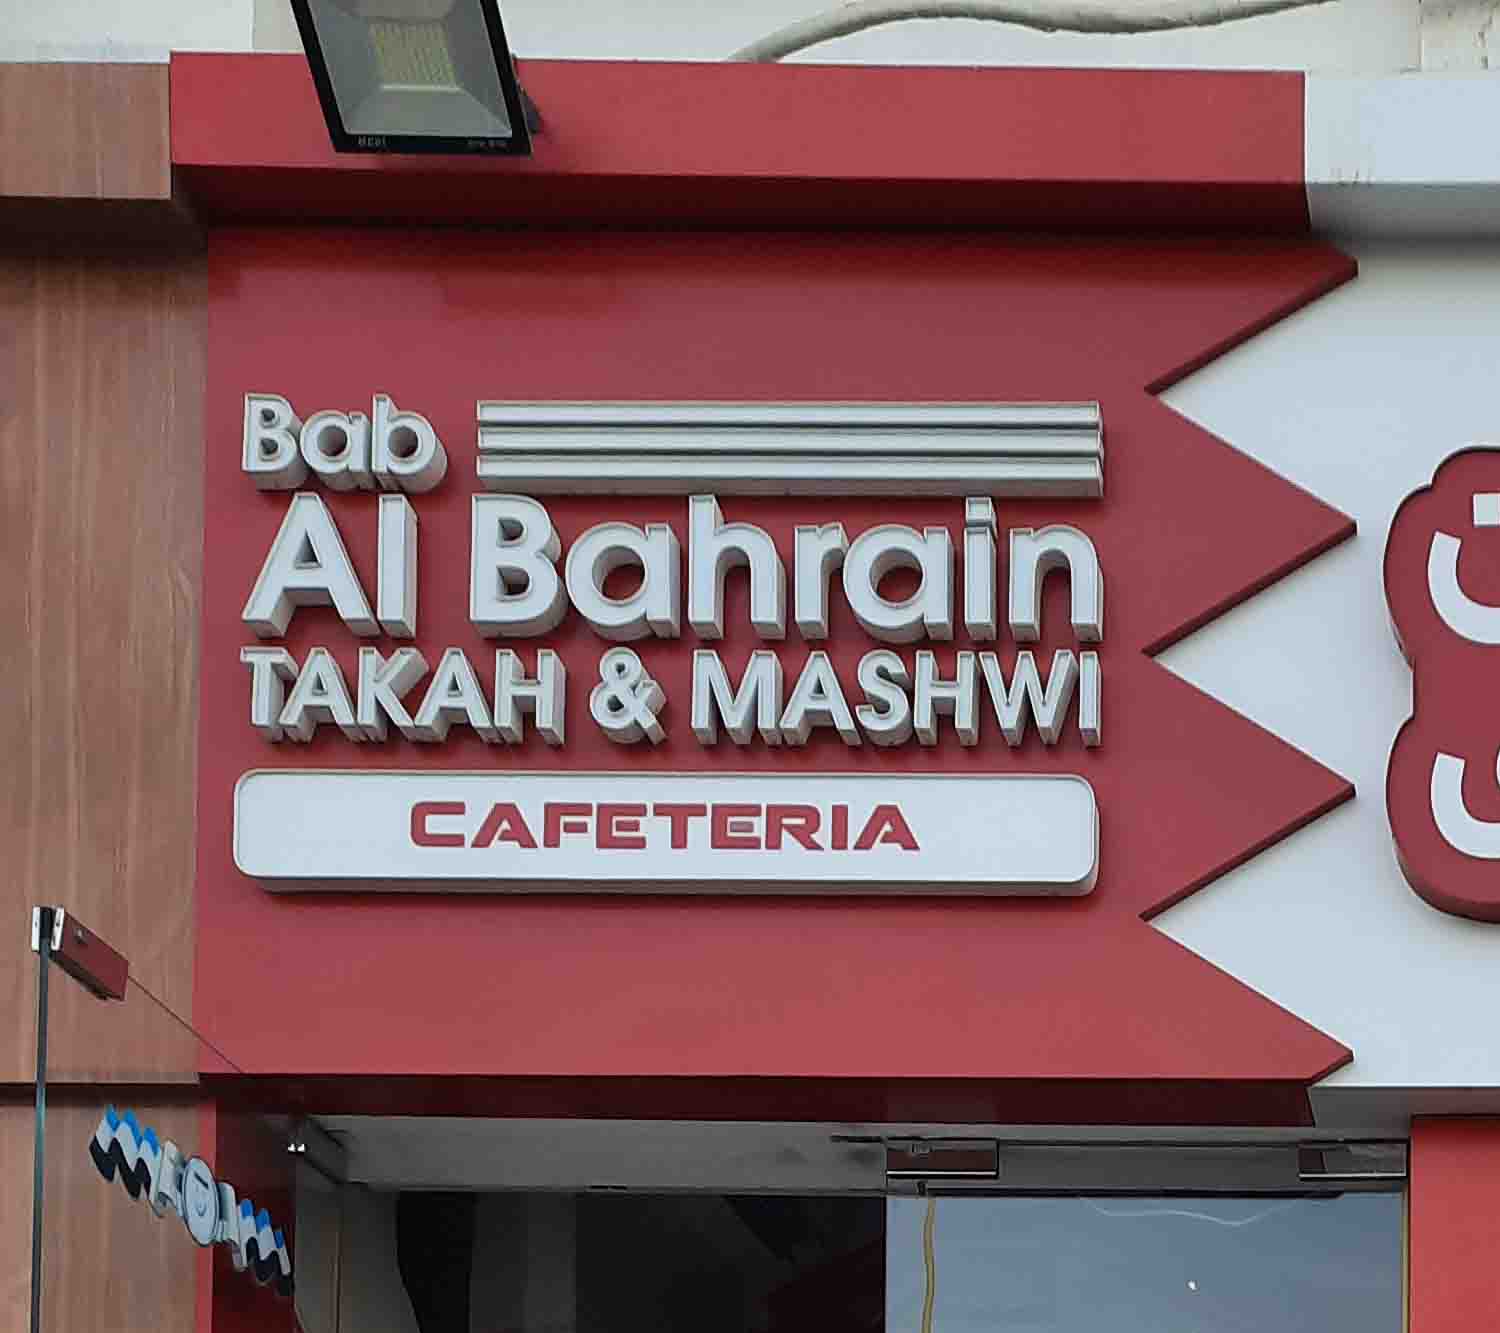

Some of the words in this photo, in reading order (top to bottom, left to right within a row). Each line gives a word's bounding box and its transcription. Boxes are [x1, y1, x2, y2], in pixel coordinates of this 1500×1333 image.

[242, 393, 448, 492] Bab
[241, 493, 418, 639] Al
[470, 494, 1104, 641] Bahrain
[240, 647, 566, 745] TAKAH
[589, 645, 667, 744] &
[691, 649, 1103, 746] MASHWI
[409, 800, 920, 851] CAFETERIA
